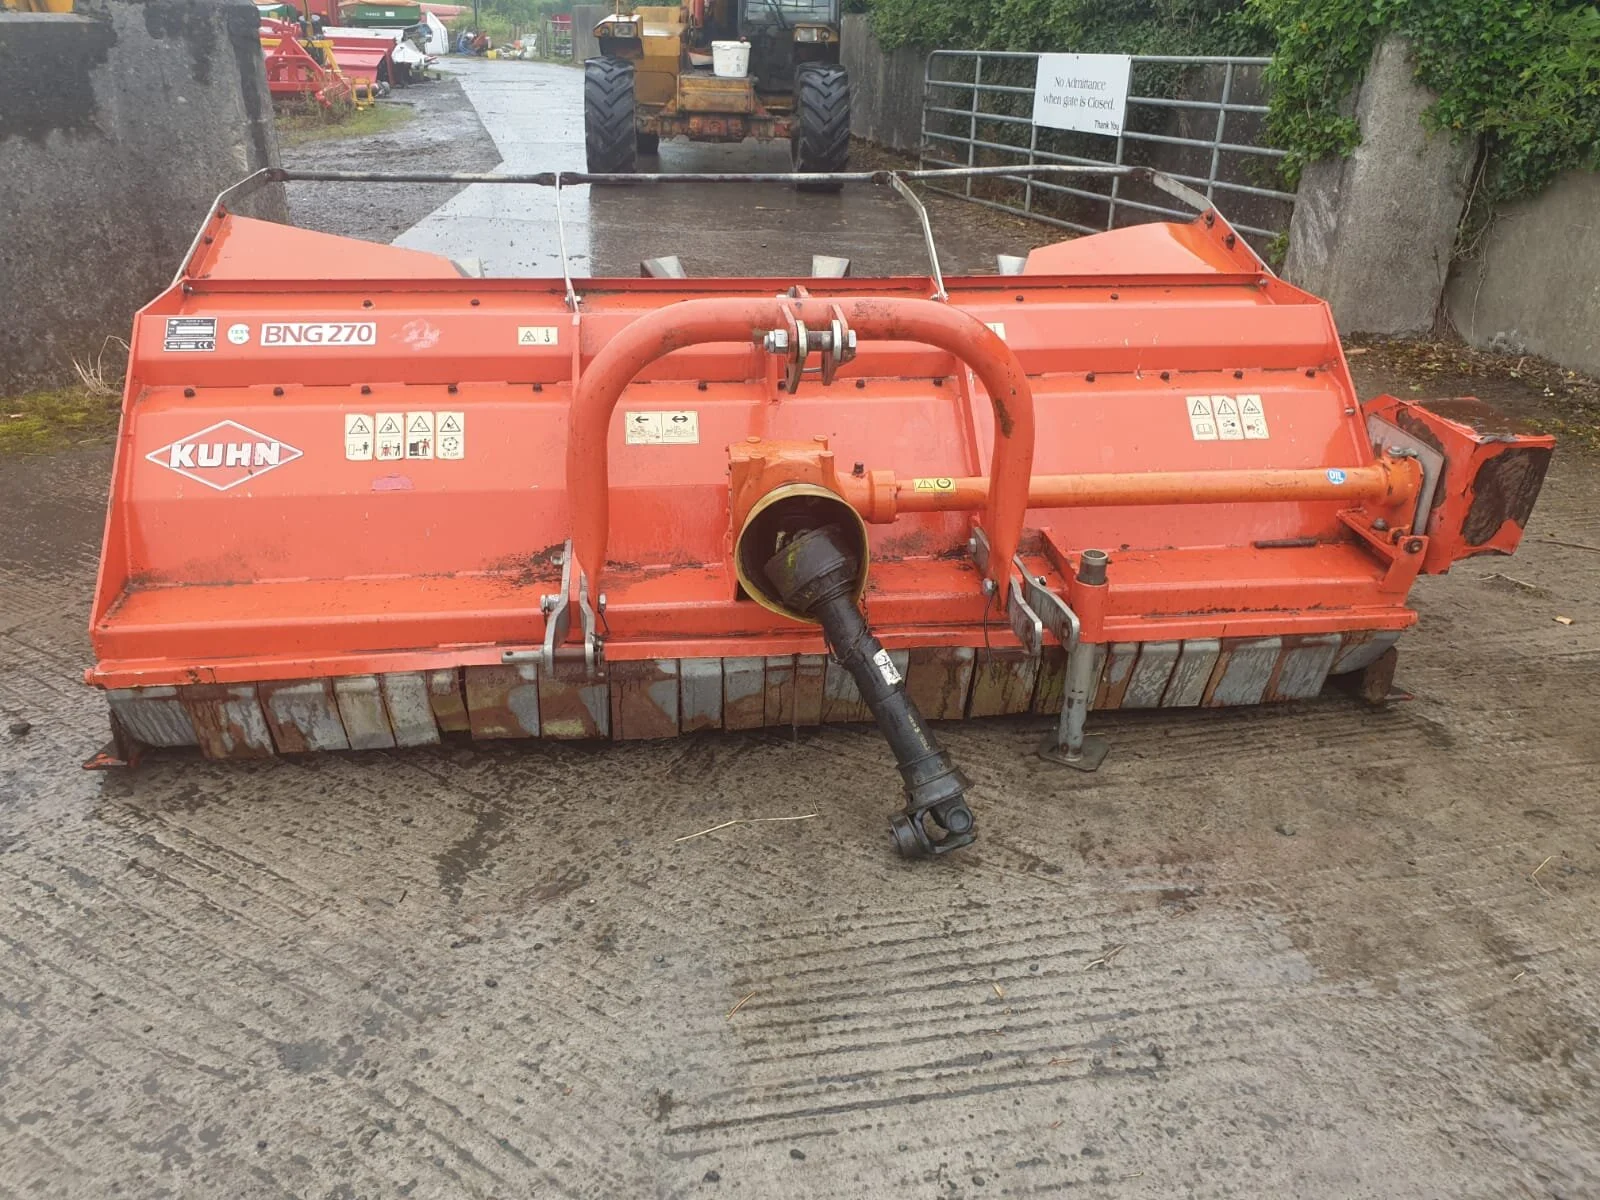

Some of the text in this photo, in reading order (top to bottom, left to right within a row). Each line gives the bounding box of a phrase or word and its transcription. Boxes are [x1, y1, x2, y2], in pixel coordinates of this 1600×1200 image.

[1055, 76, 1106, 91] No Admittance
[1043, 92, 1061, 105] when
[1063, 96, 1078, 108] gate
[1080, 96, 1086, 106] is
[1094, 119, 1119, 131] Thank You
[264, 325, 323, 346] BNG
[327, 324, 373, 344] 270
[169, 442, 280, 468] KUHN
[1329, 470, 1344, 481] OIL
